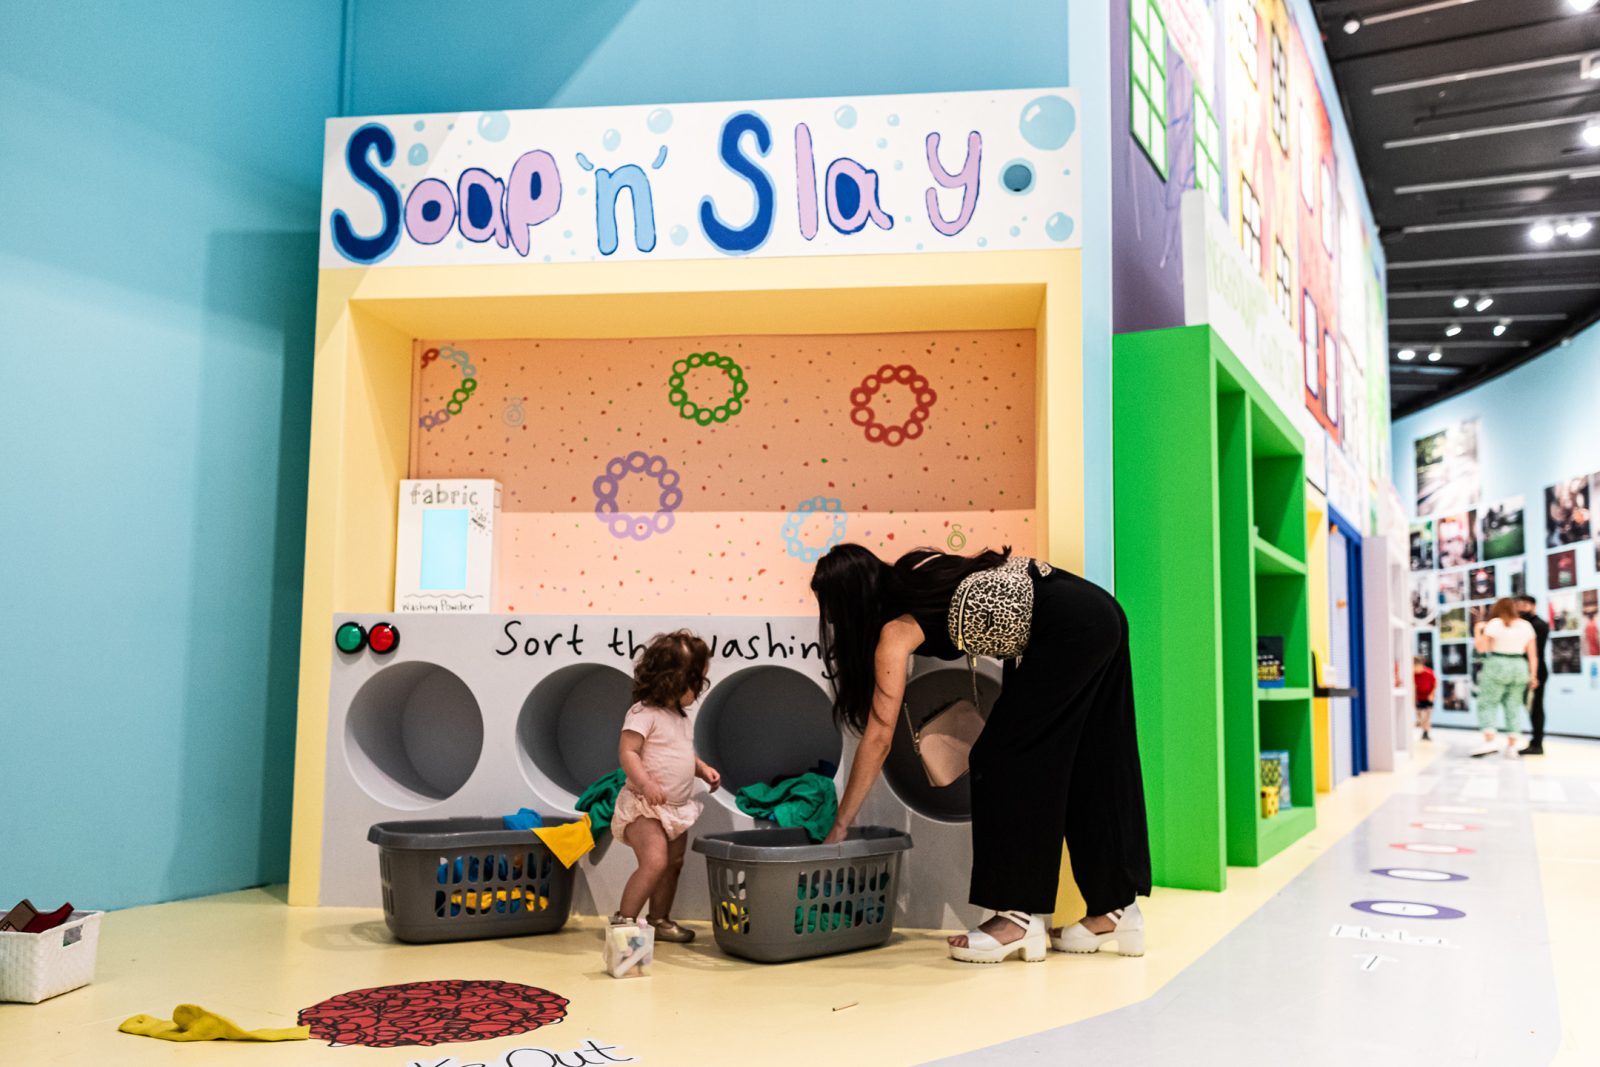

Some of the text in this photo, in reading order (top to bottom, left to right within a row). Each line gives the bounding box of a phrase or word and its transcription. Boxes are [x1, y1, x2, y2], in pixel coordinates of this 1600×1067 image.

[330, 122, 563, 266] Soap
[699, 109, 983, 257] Slay
[410, 483, 479, 506] fabric
[495, 620, 584, 657] Sort
[607, 627, 649, 660] th
